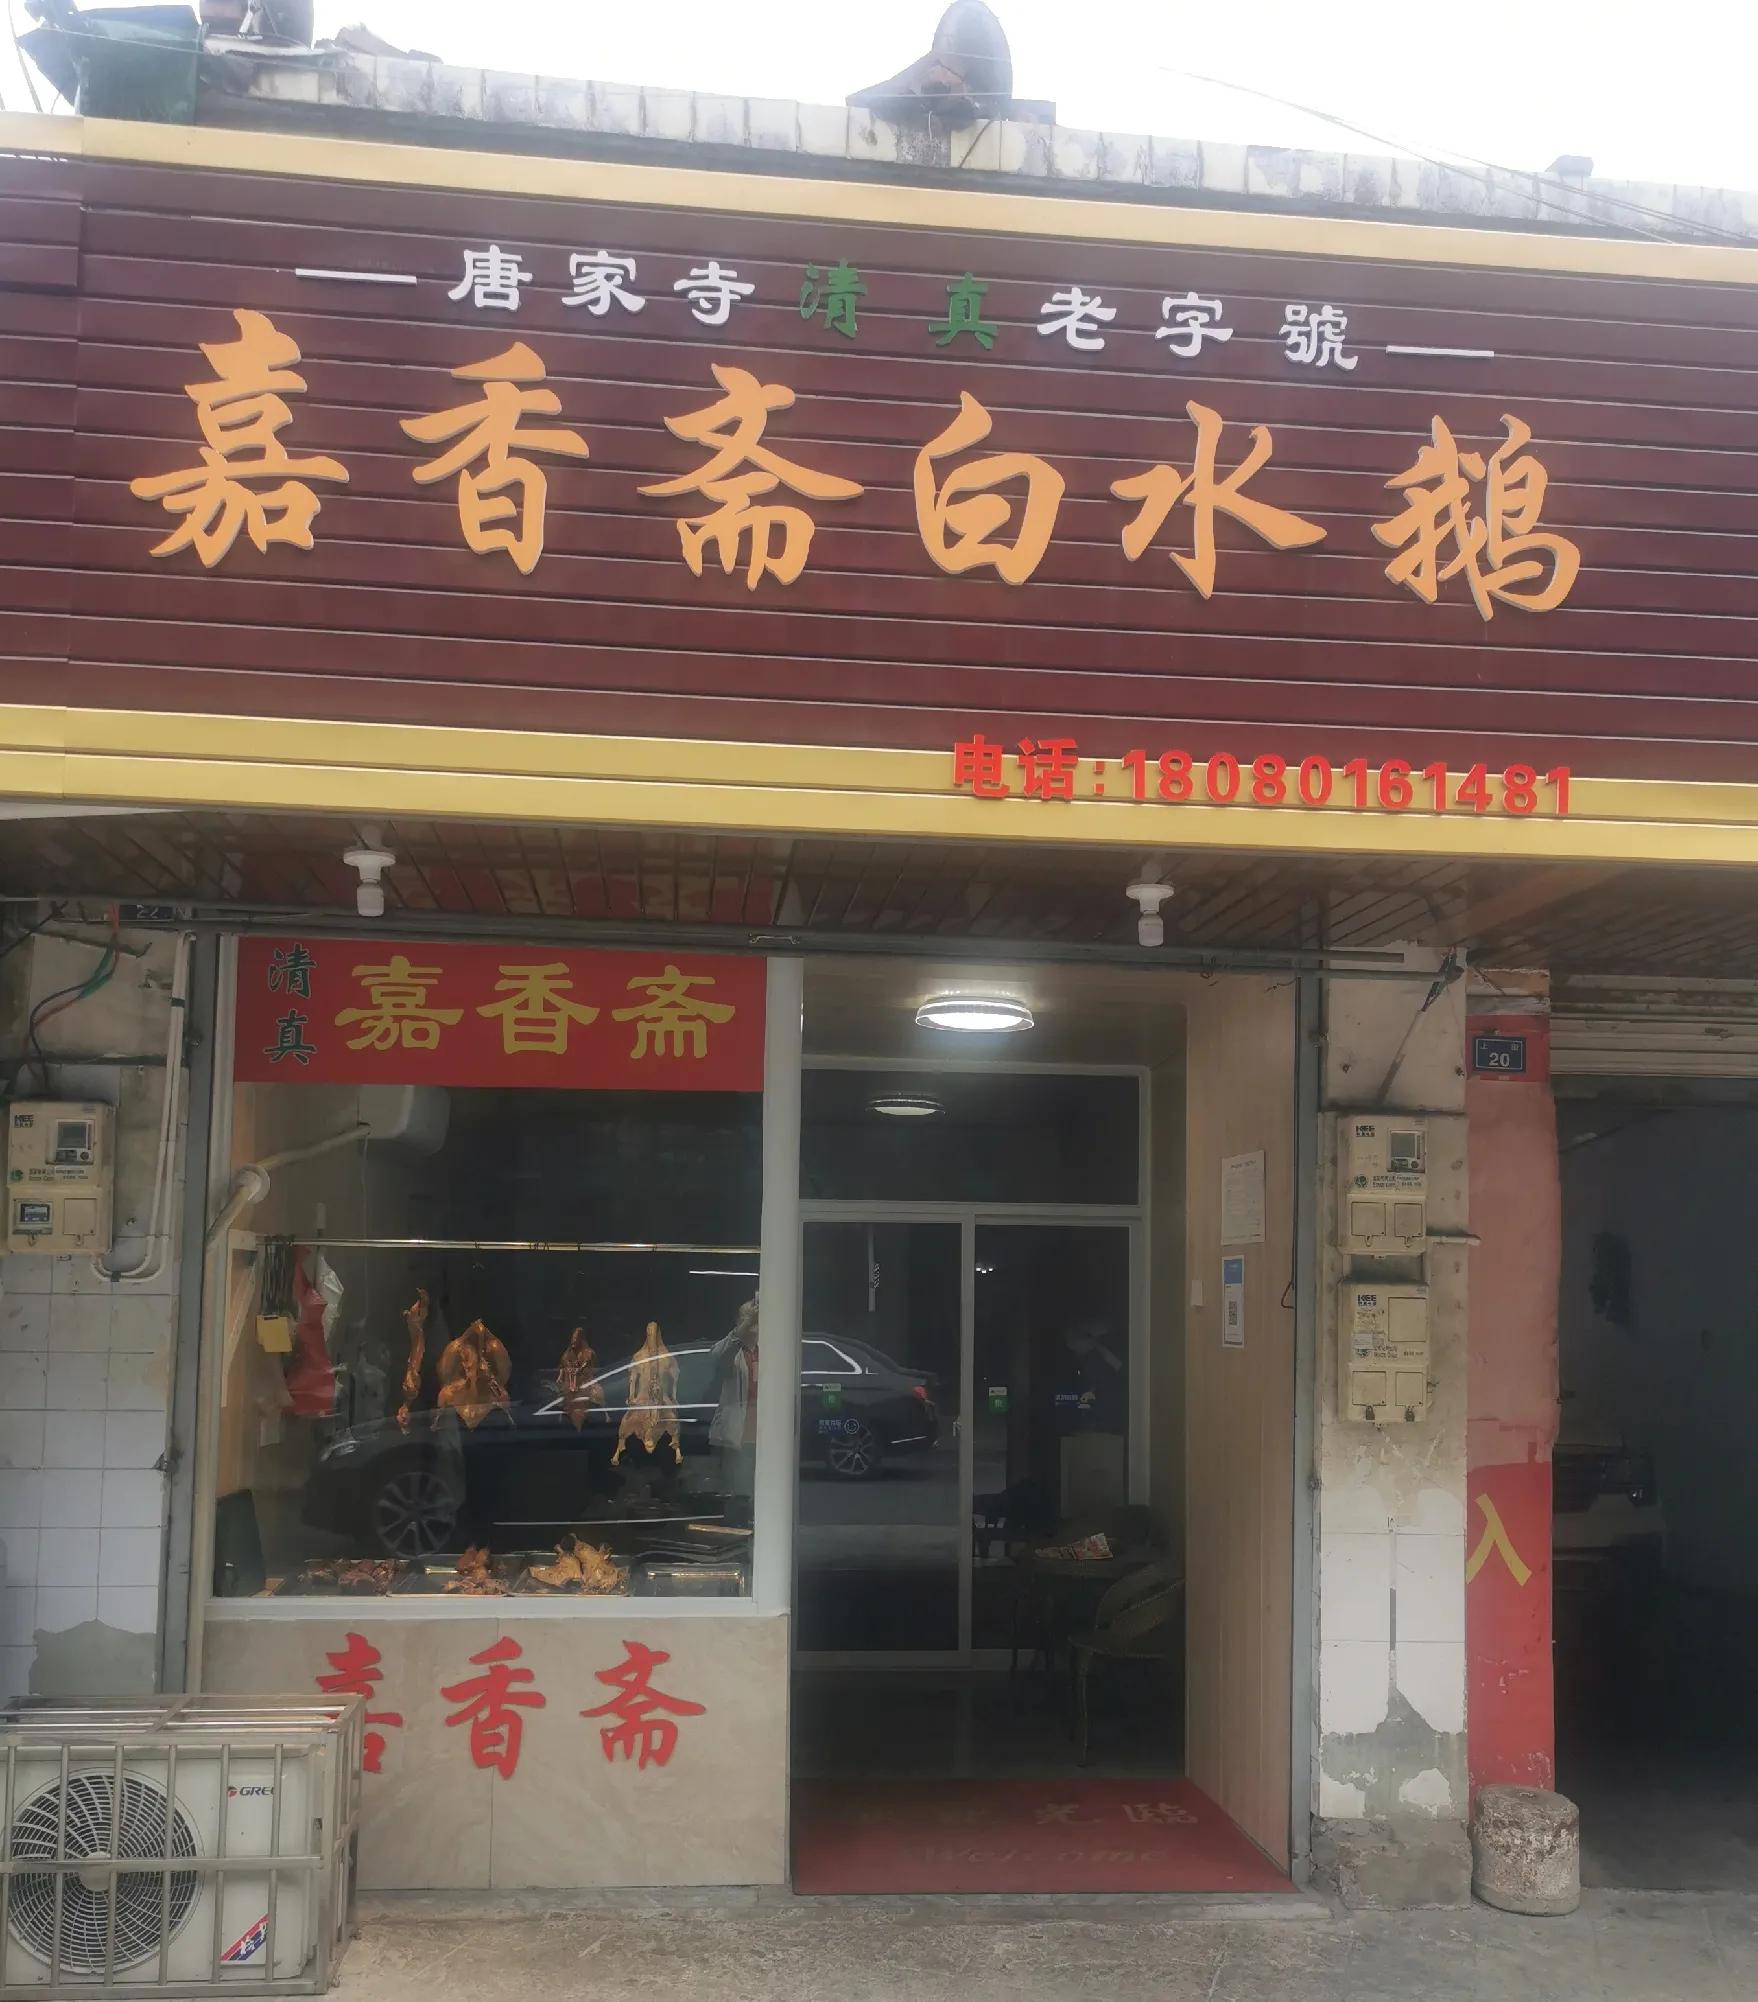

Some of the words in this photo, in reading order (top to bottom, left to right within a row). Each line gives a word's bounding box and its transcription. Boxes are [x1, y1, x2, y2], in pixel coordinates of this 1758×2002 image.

[130, 307, 1583, 621] 嘉香斋白水鹅
[953, 733, 1573, 816] 电话:18080161481
[335, 955, 736, 1060] 嘉香斋
[1488, 1053, 1510, 1067] 20
